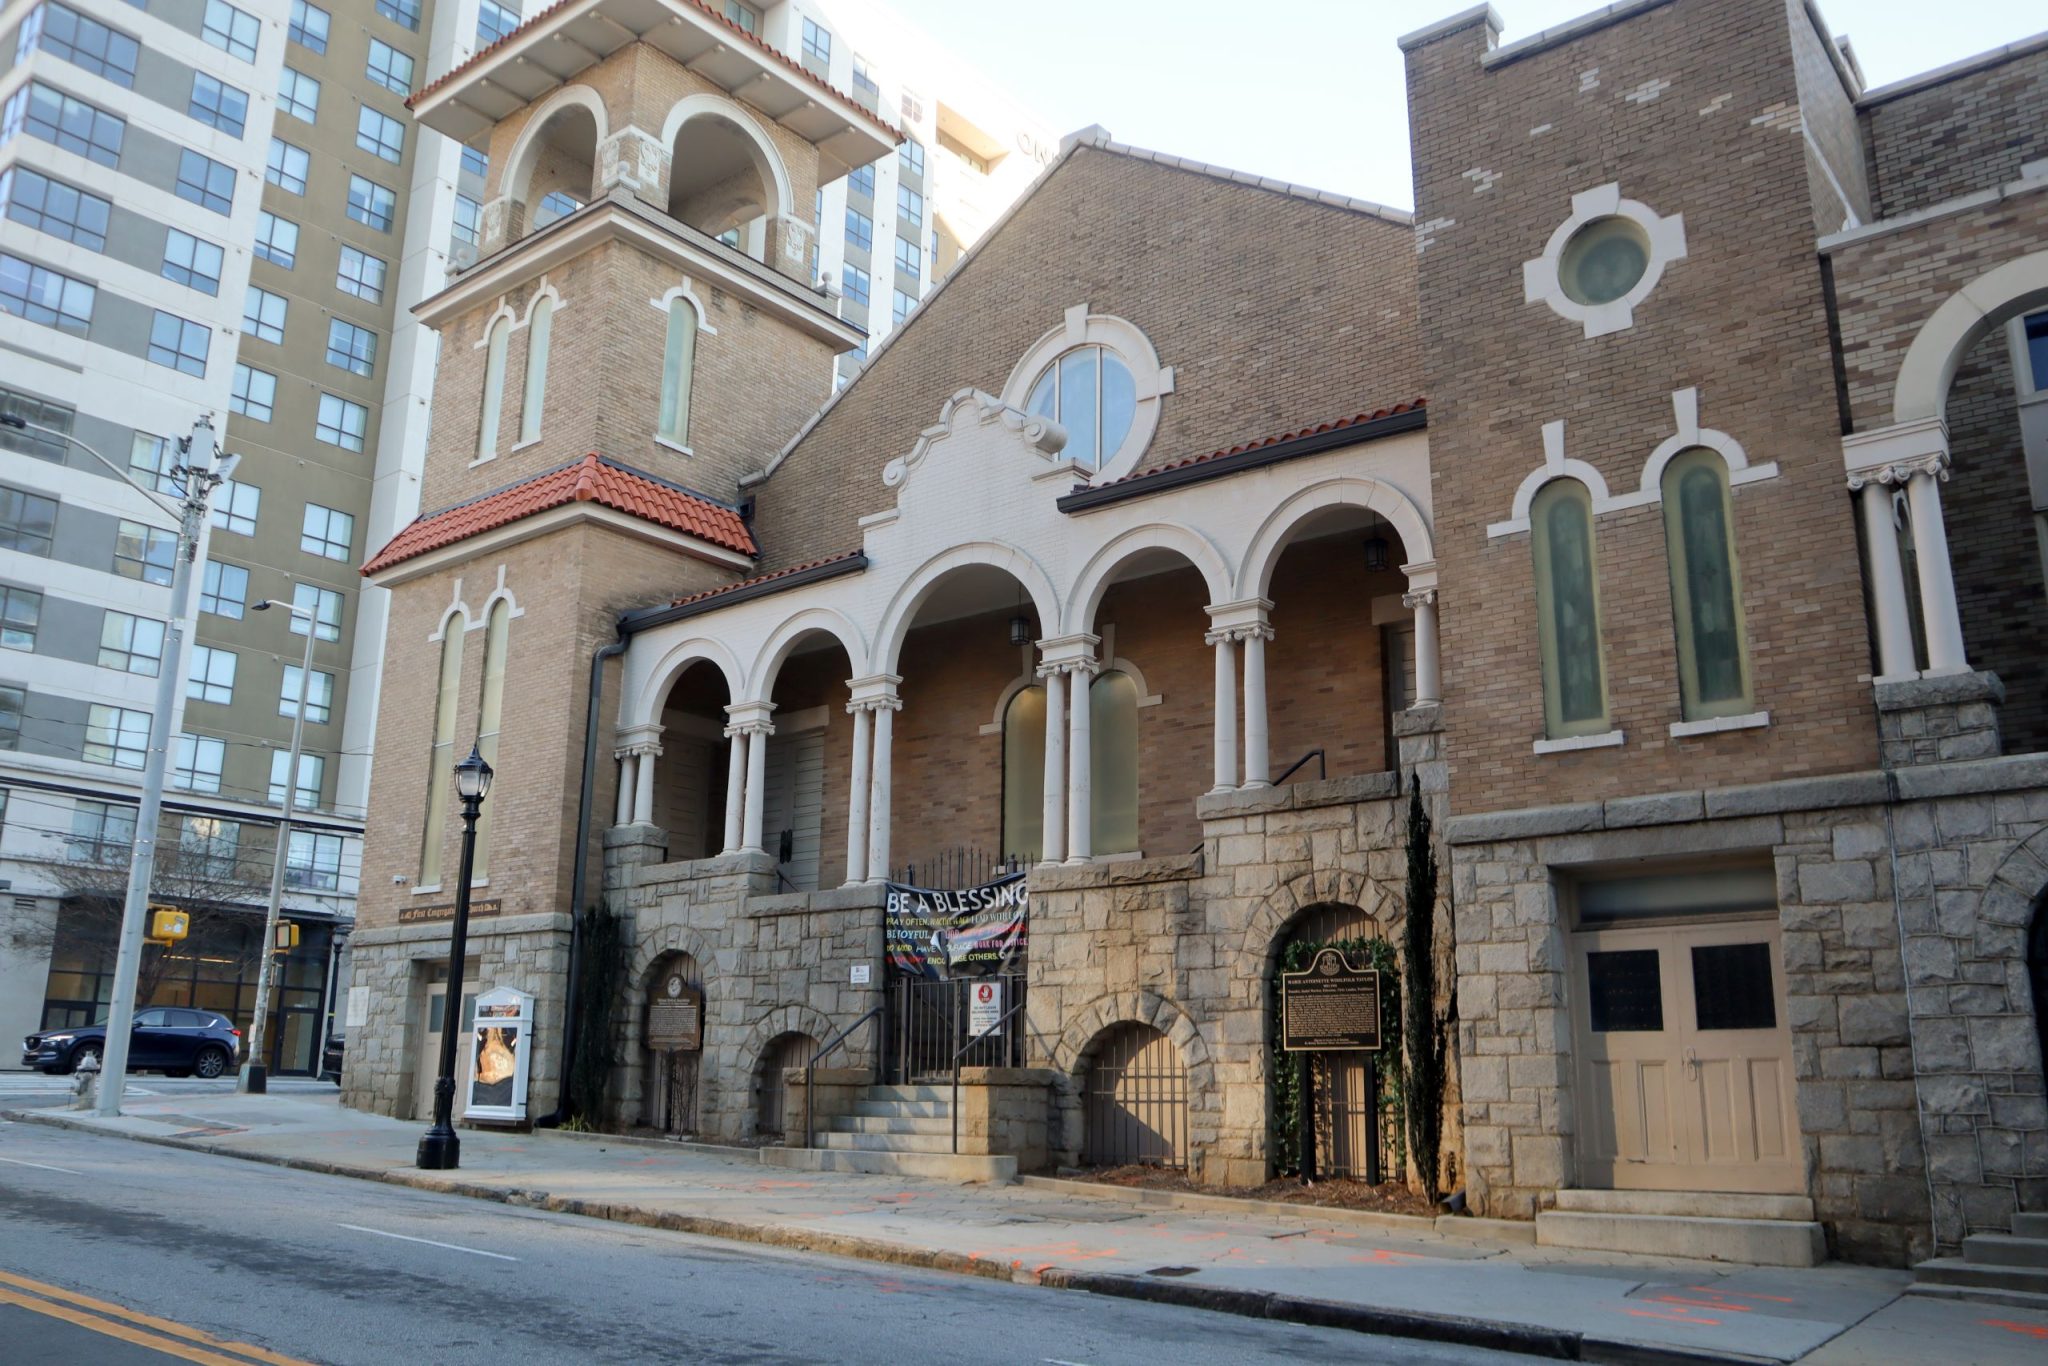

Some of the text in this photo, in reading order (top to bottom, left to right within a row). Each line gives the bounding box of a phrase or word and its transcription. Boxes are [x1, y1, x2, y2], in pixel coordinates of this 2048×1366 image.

[887, 884, 1028, 913] BE A BLESSING
[886, 917, 904, 926] PRAY
[905, 918, 930, 926] OFTEN.
